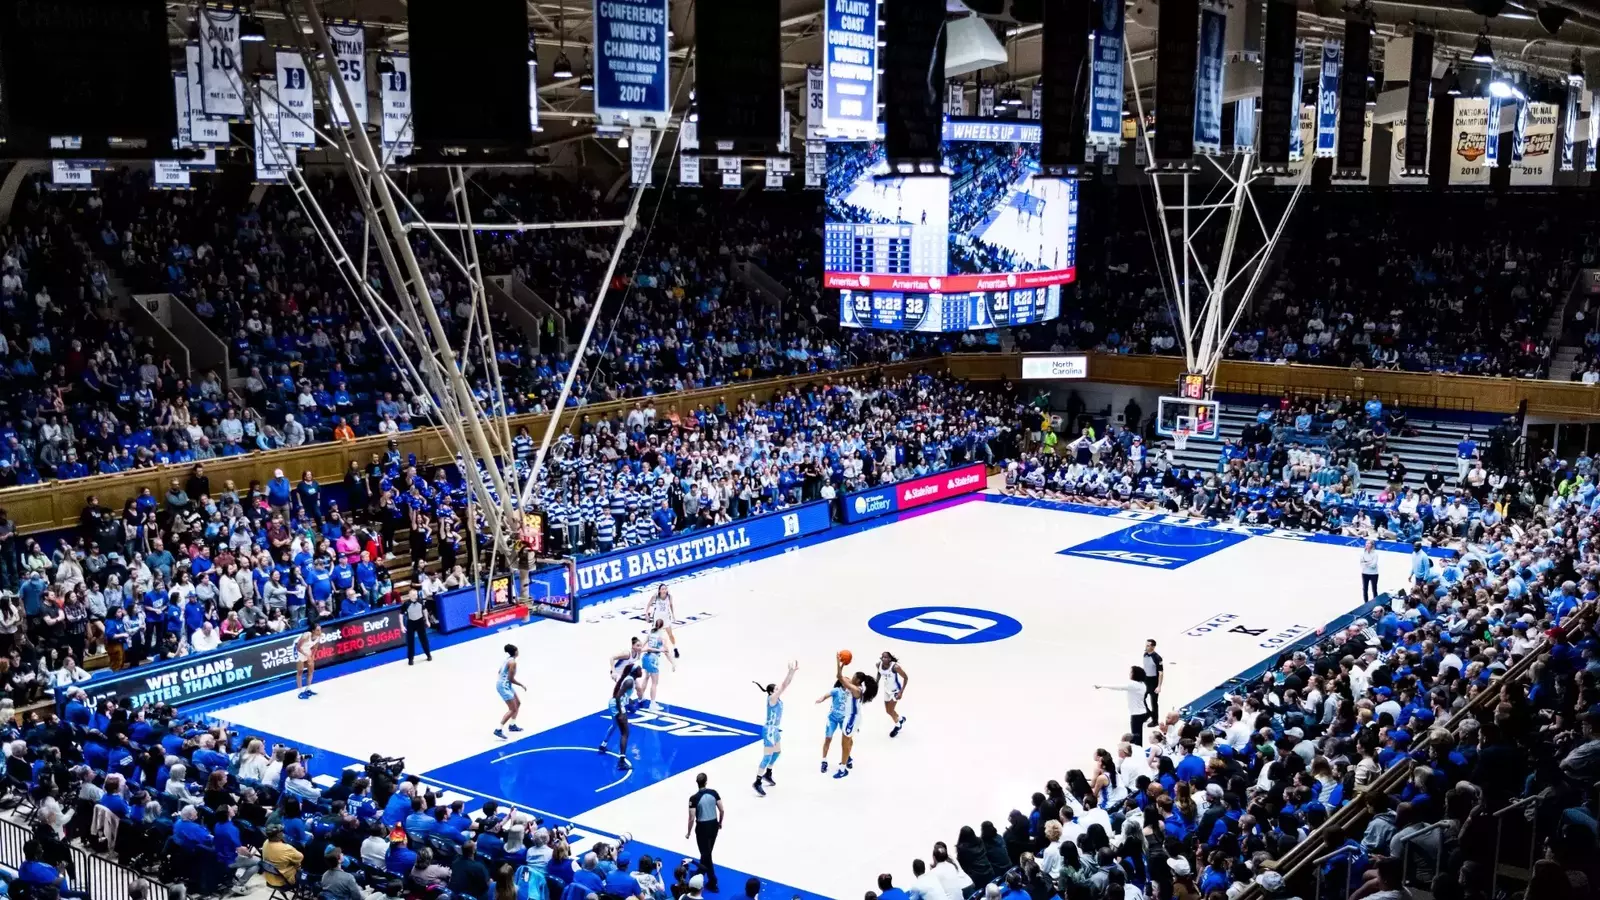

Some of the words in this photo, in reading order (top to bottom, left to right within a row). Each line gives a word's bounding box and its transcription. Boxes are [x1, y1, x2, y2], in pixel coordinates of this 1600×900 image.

[600, 2, 664, 25] CONFERENCE
[835, 0, 870, 17] ATLANTIC
[610, 22, 656, 42] WOMEN'S
[841, 15, 865, 31] COAST
[337, 41, 363, 55] EYMAN
[828, 29, 875, 50] CONFERENCE
[212, 47, 234, 70] 10
[604, 40, 662, 62] CHAMPIONS
[619, 85, 647, 103] 2001
[1323, 90, 1337, 115] 20
[1455, 117, 1488, 126] CHAMPION
[953, 124, 998, 139] WHEELS
[1000, 125, 1013, 139] UP
[1460, 167, 1480, 175] 2010
[1522, 167, 1543, 175] 2015
[829, 277, 859, 286] Ameritas
[892, 279, 928, 289] Ameritas
[977, 278, 1008, 289] Ameritas
[855, 296, 871, 311] 31
[874, 297, 902, 311] 8:22
[905, 298, 924, 314] 32
[994, 291, 1009, 311] 31
[1014, 290, 1033, 306] 8:22
[1036, 288, 1046, 306] 32
[1187, 384, 1200, 399] 18
[866, 499, 891, 513] Lottery
[563, 553, 624, 595] DUKE
[627, 526, 750, 579] BASKETBALL
[341, 624, 364, 638] Coke
[363, 616, 389, 633] Ever?
[1187, 612, 1240, 637] COACH
[1227, 624, 1269, 637] K
[336, 638, 365, 654] ZERO
[366, 627, 402, 647] SUGAR
[1259, 623, 1309, 649] COURT
[146, 671, 178, 691] WET
[180, 657, 234, 682] CLEANS
[129, 684, 181, 709] BETTER
[183, 673, 223, 695] THAN
[225, 665, 253, 684] DRY
